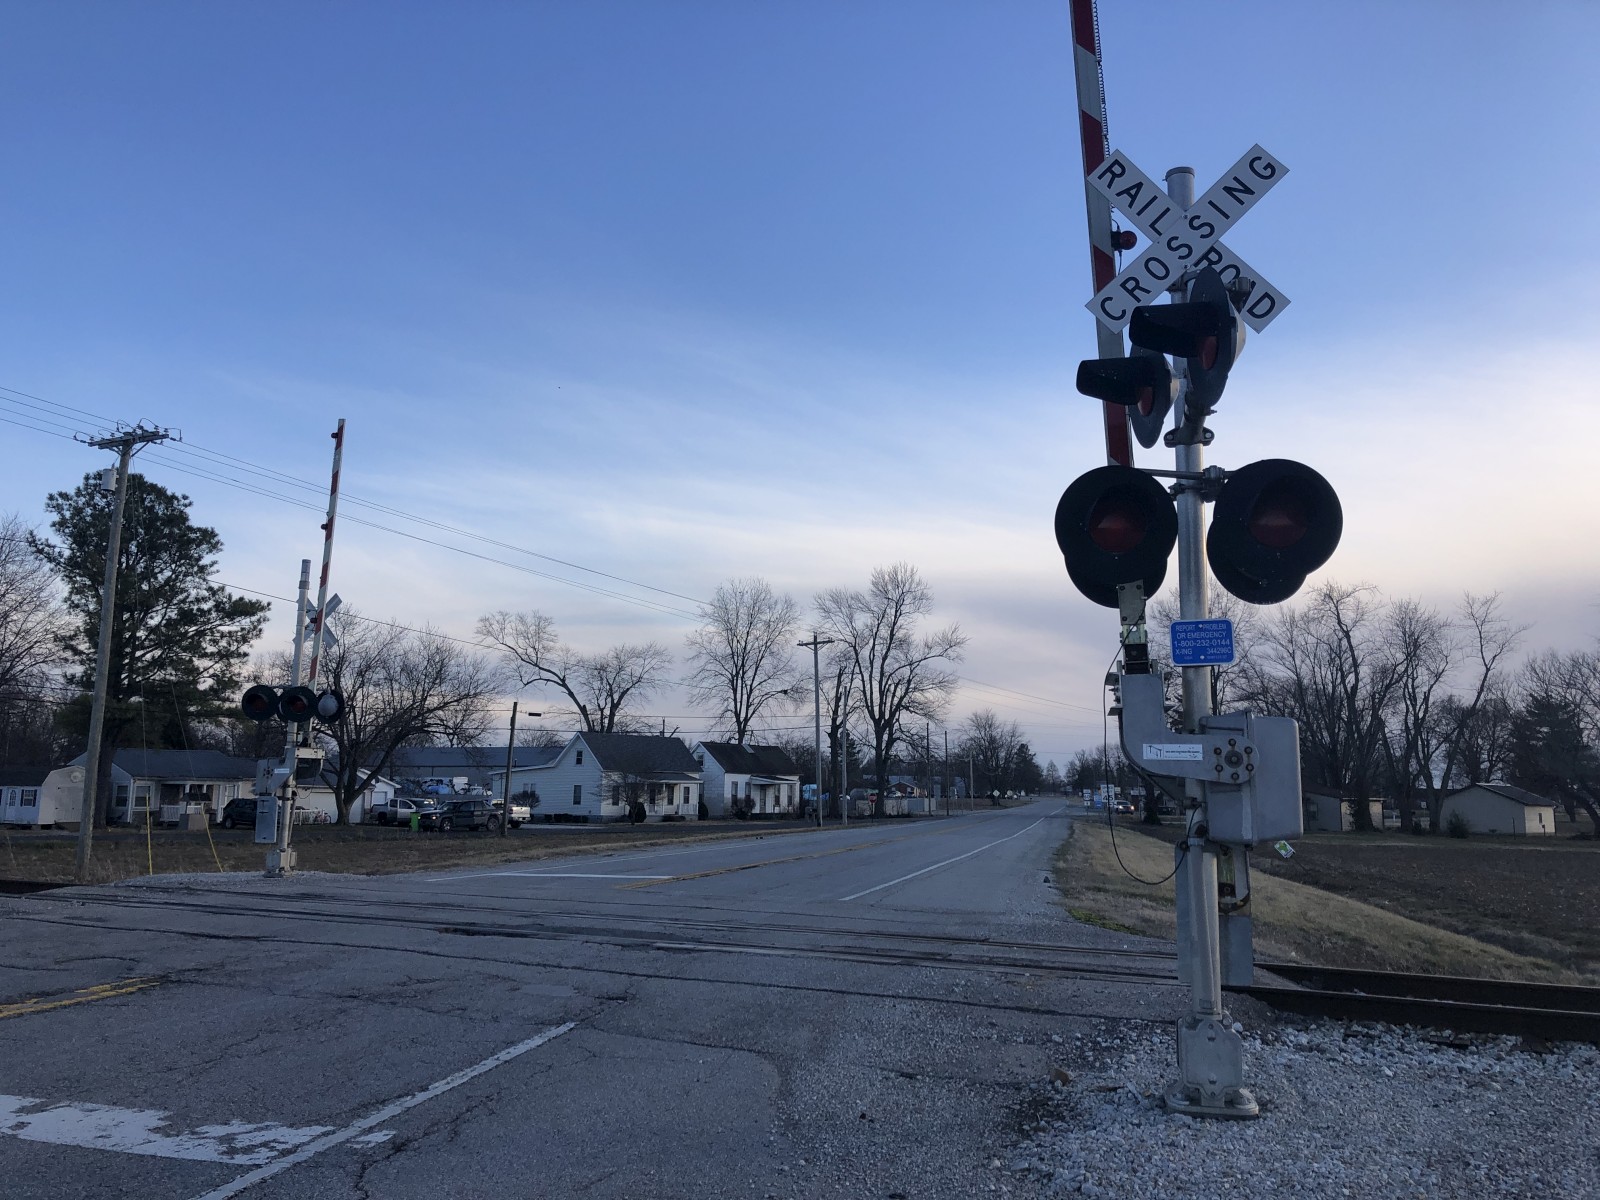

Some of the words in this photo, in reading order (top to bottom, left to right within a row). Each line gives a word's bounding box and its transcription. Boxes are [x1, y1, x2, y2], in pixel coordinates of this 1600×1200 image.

[1097, 158, 1171, 236] RAIL
[1100, 155, 1277, 321] CROSSING
[1174, 639, 1230, 647] 1-800-232-0144
